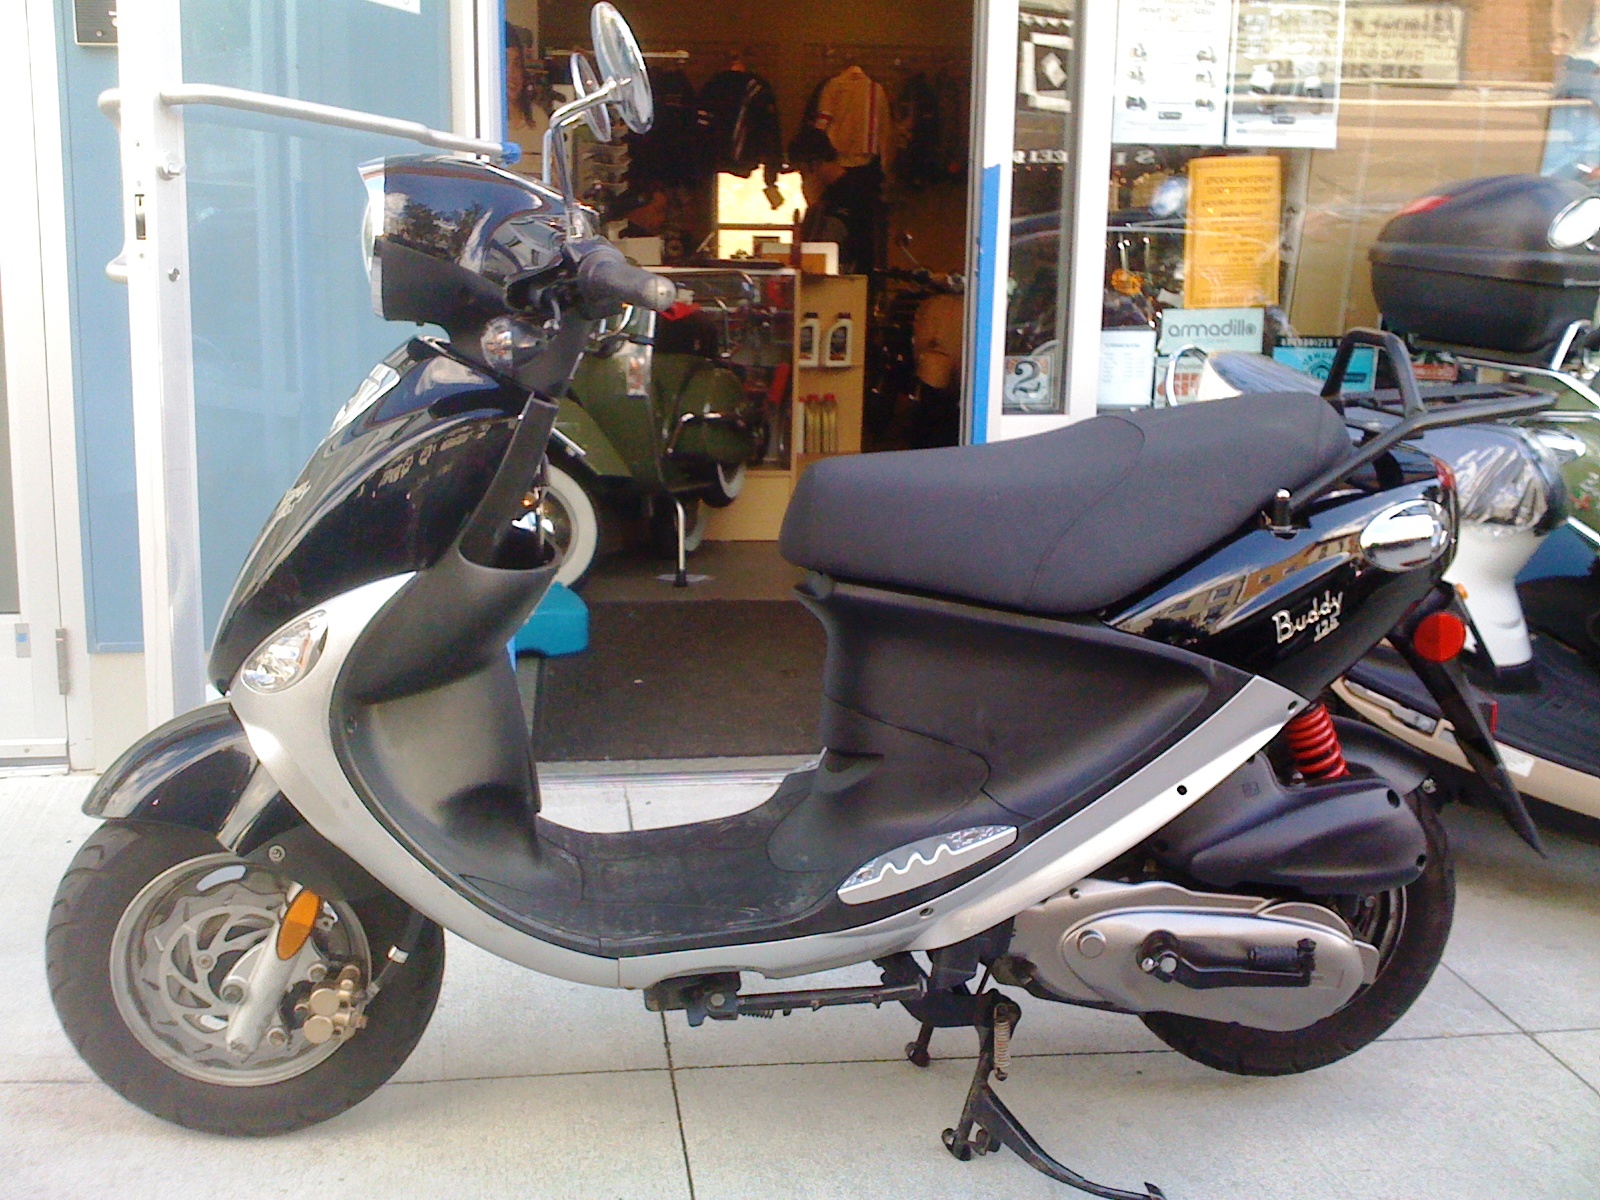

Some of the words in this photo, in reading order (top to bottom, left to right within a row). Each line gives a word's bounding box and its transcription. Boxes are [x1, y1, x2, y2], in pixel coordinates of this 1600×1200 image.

[1168, 318, 1257, 338] armadillo
[1012, 360, 1041, 394] 2
[1271, 590, 1343, 643] Buddy
[1313, 618, 1340, 643] 125
